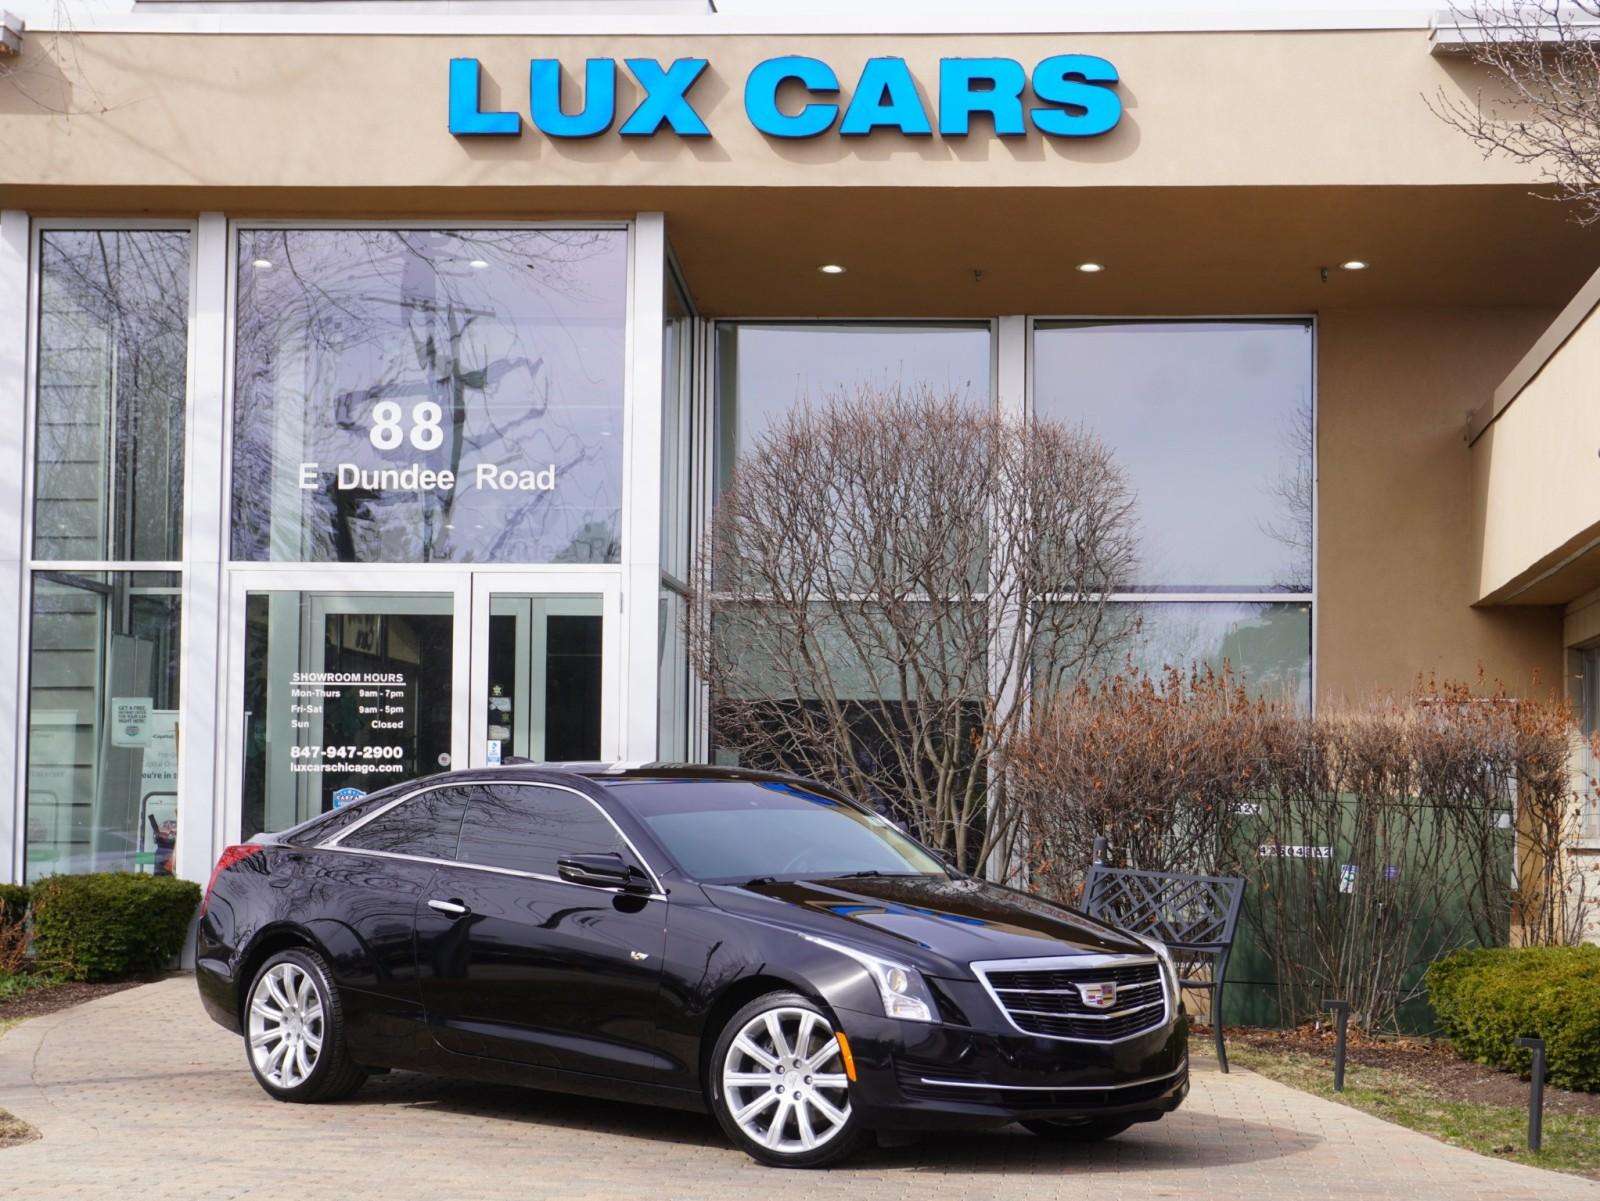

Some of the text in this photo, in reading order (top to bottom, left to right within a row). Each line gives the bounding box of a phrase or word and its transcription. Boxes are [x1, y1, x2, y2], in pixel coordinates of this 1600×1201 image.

[449, 54, 1122, 138] LUX CARS
[369, 401, 444, 451] 88
[299, 462, 556, 490] E Dundee Road
[292, 672, 404, 683] SHOWROOM HOURS
[291, 689, 341, 698] Mon-Thurs
[359, 689, 378, 698] 9am
[385, 689, 404, 699] 7pm
[291, 704, 323, 713] Fri-Sat
[359, 705, 378, 714] 9am
[385, 705, 404, 715] 5pm
[291, 719, 404, 729] Sun Closed
[290, 746, 404, 759] 847-947-2900
[290, 762, 403, 774] luxcarschicago.com
